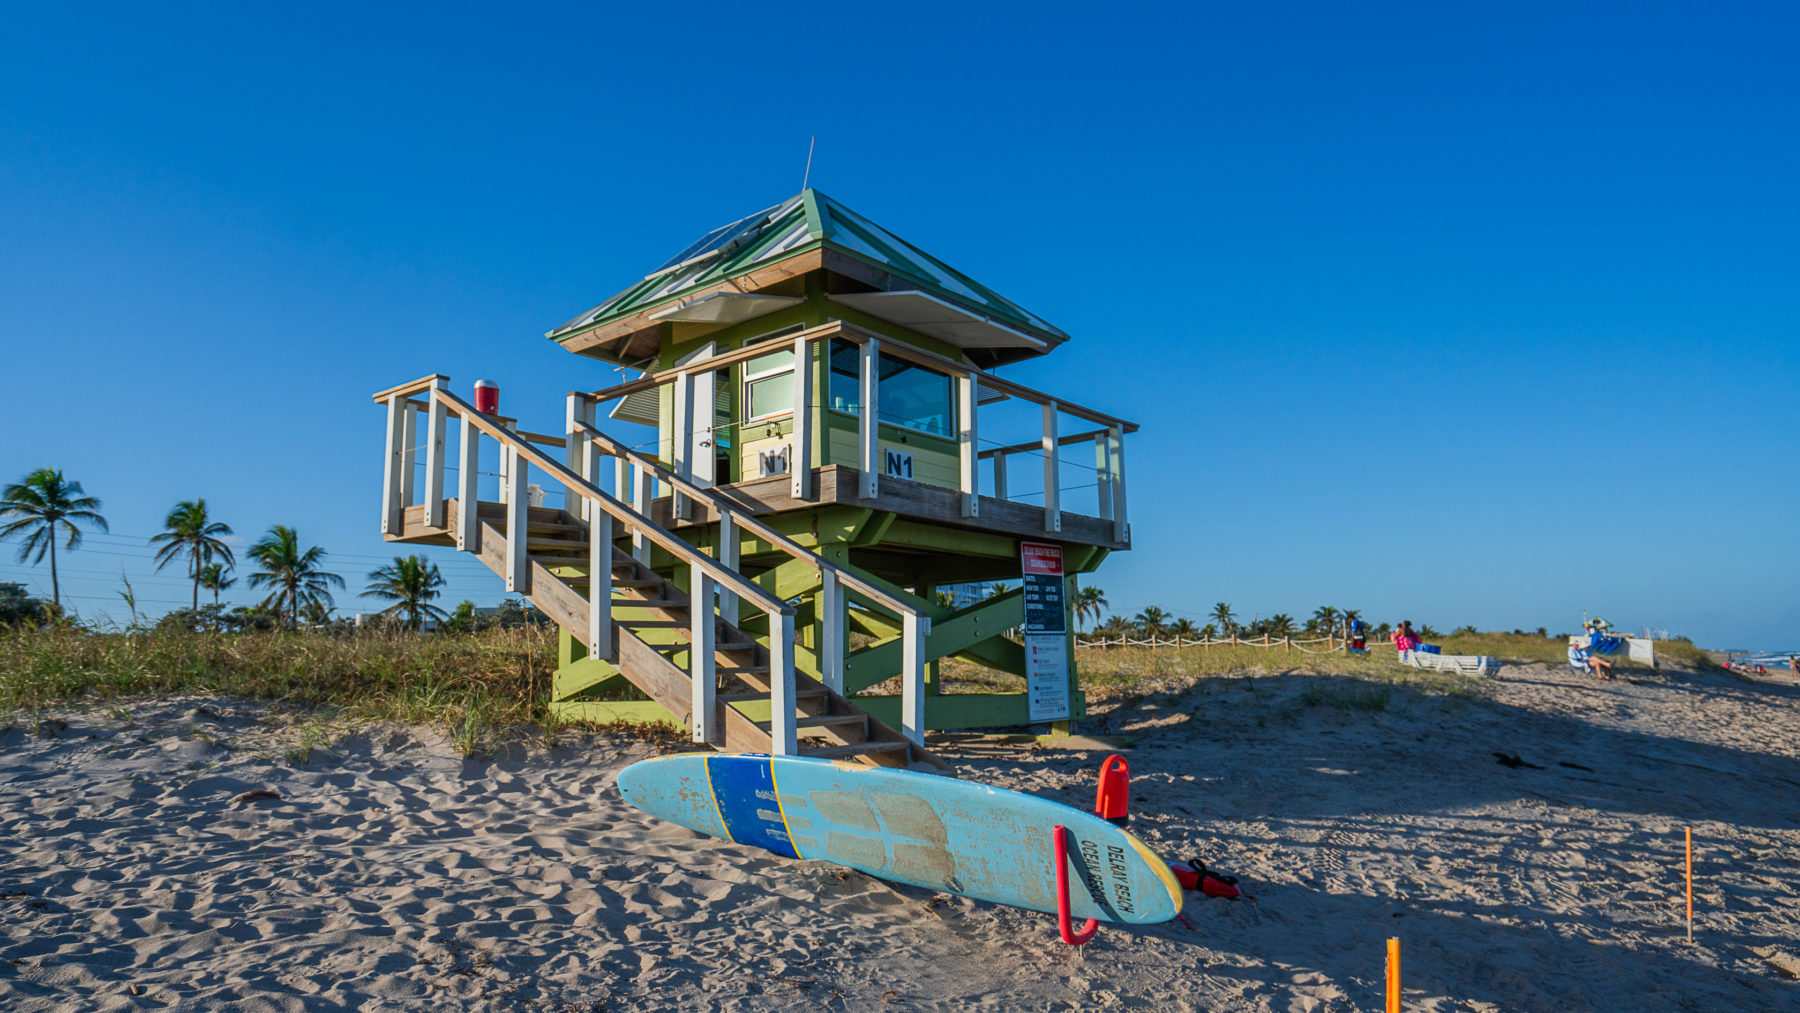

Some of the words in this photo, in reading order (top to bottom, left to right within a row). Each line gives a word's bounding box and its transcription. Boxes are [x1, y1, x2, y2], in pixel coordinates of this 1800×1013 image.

[759, 447, 788, 475] N1
[888, 452, 913, 478] N1
[1081, 840, 1102, 872] OCEAN
[1107, 845, 1128, 884] DELRAY
[1086, 872, 1109, 907] RESCUE
[1114, 883, 1135, 914] BEACH
